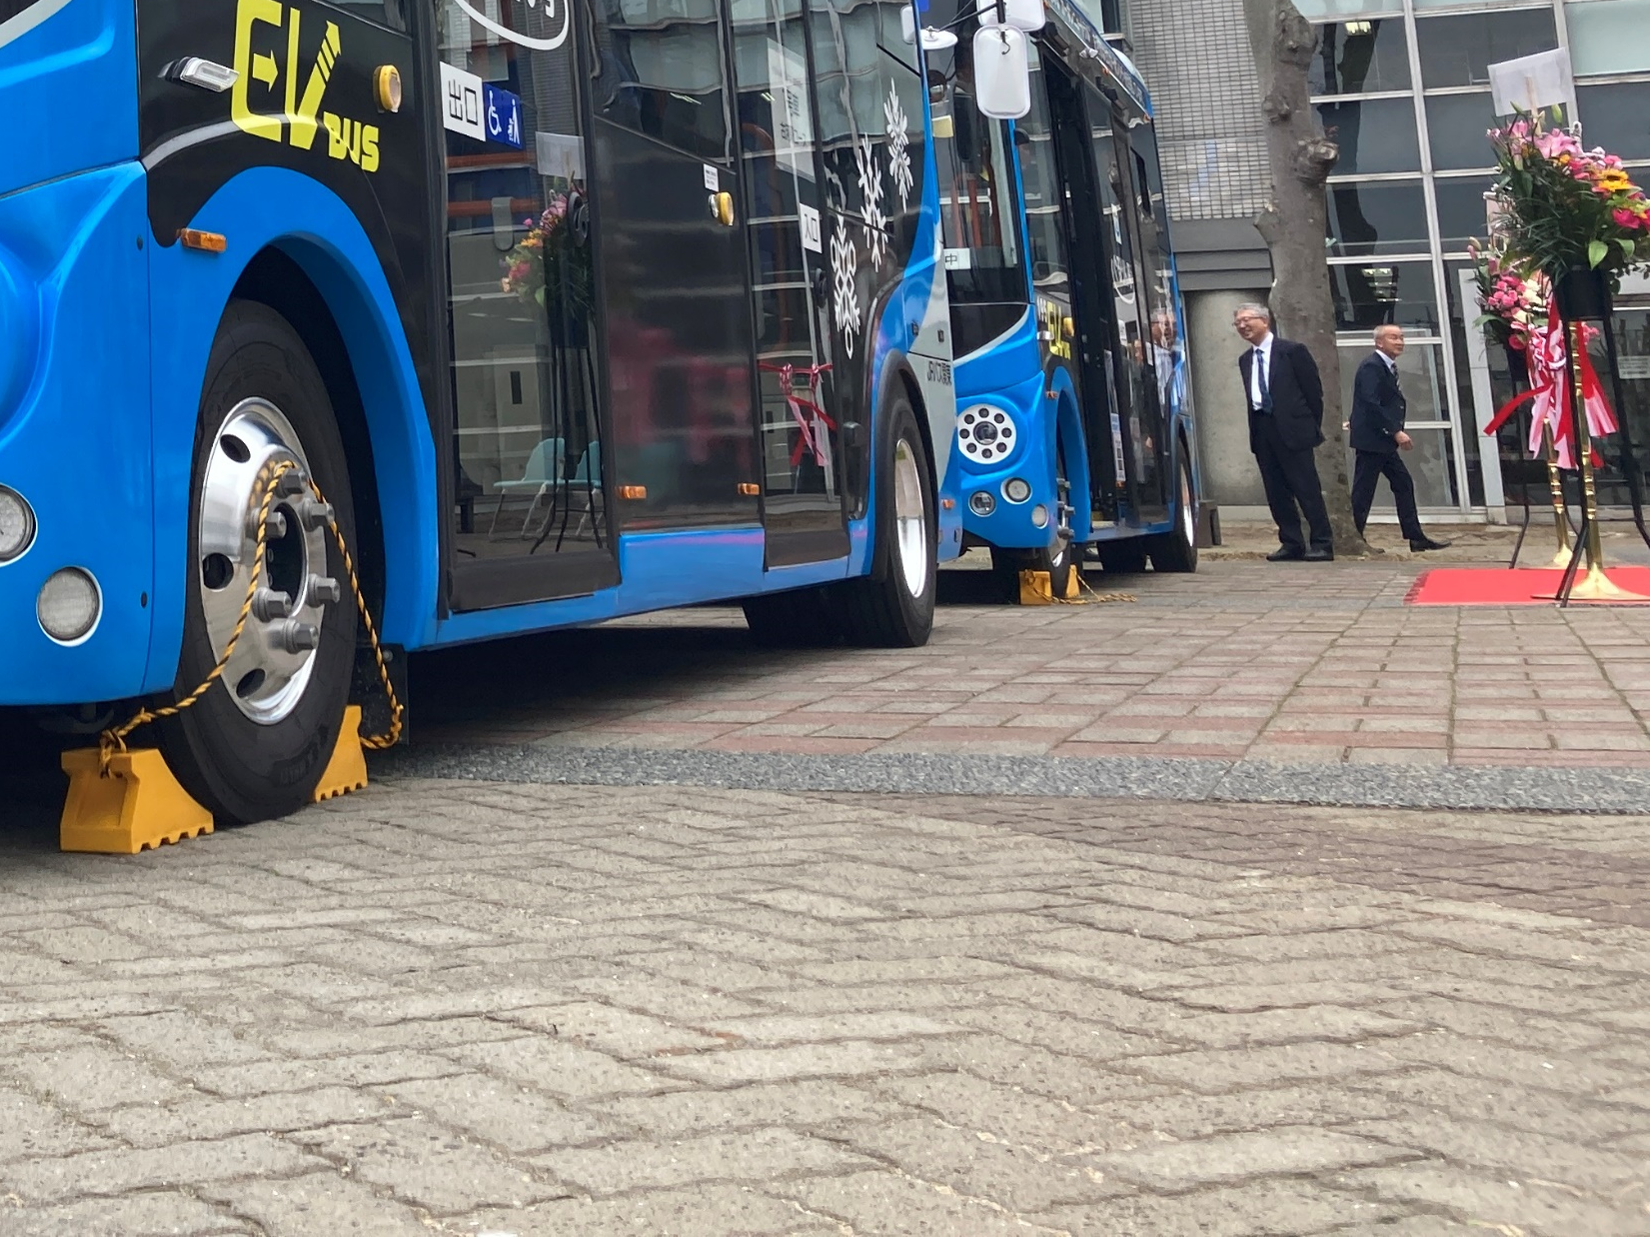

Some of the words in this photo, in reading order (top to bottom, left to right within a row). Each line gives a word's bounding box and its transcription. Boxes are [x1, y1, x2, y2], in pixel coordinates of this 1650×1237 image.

[448, 78, 479, 128] 出口
[322, 112, 380, 173] BUS
[803, 213, 818, 243] 入口
